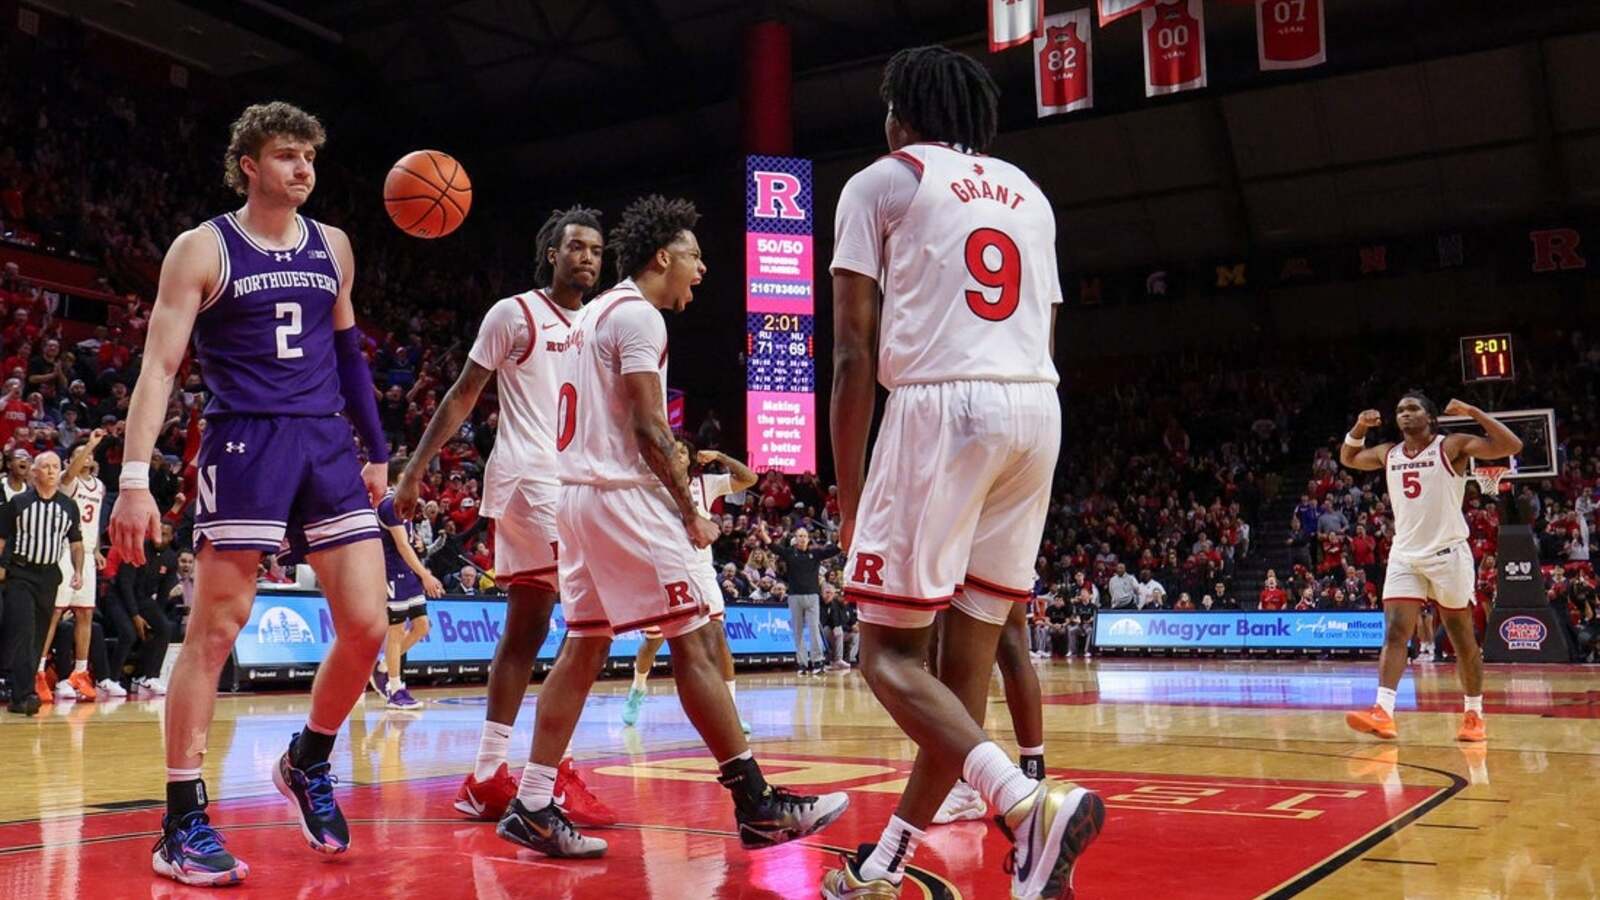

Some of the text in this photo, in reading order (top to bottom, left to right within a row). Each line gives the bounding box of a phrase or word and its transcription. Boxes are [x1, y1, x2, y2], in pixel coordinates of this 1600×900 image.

[1158, 25, 1188, 49] 00
[1048, 48, 1077, 71] 82
[754, 171, 805, 220] R
[950, 179, 1025, 210] GRANT
[757, 239, 803, 255] 50/50
[1530, 229, 1586, 272] R
[233, 271, 338, 298] NORTHWESTERN
[964, 227, 1022, 322] 9
[1215, 264, 1247, 287] M
[275, 302, 304, 359] 2
[764, 315, 800, 331] 2:01
[758, 331, 804, 341] RU NU
[1475, 339, 1507, 354] 2:01
[758, 341, 773, 354] 71
[789, 343, 806, 355] 69
[1482, 353, 1505, 375] 11
[557, 382, 577, 452] 0
[763, 400, 800, 414] Making
[757, 414, 805, 426] the world
[762, 427, 800, 439] of work
[761, 442, 802, 453] a better
[768, 455, 796, 467] place
[1391, 461, 1434, 471] RUTGERS
[196, 465, 217, 516] N
[1402, 471, 1422, 499] 5
[82, 504, 94, 523] 3
[852, 552, 884, 586] R
[665, 581, 695, 607] R
[437, 608, 500, 643] Bank
[723, 613, 757, 640] ank
[1147, 618, 1231, 640] Magyar
[1236, 617, 1292, 636] Bank
[1328, 620, 1383, 631] Magnificent
